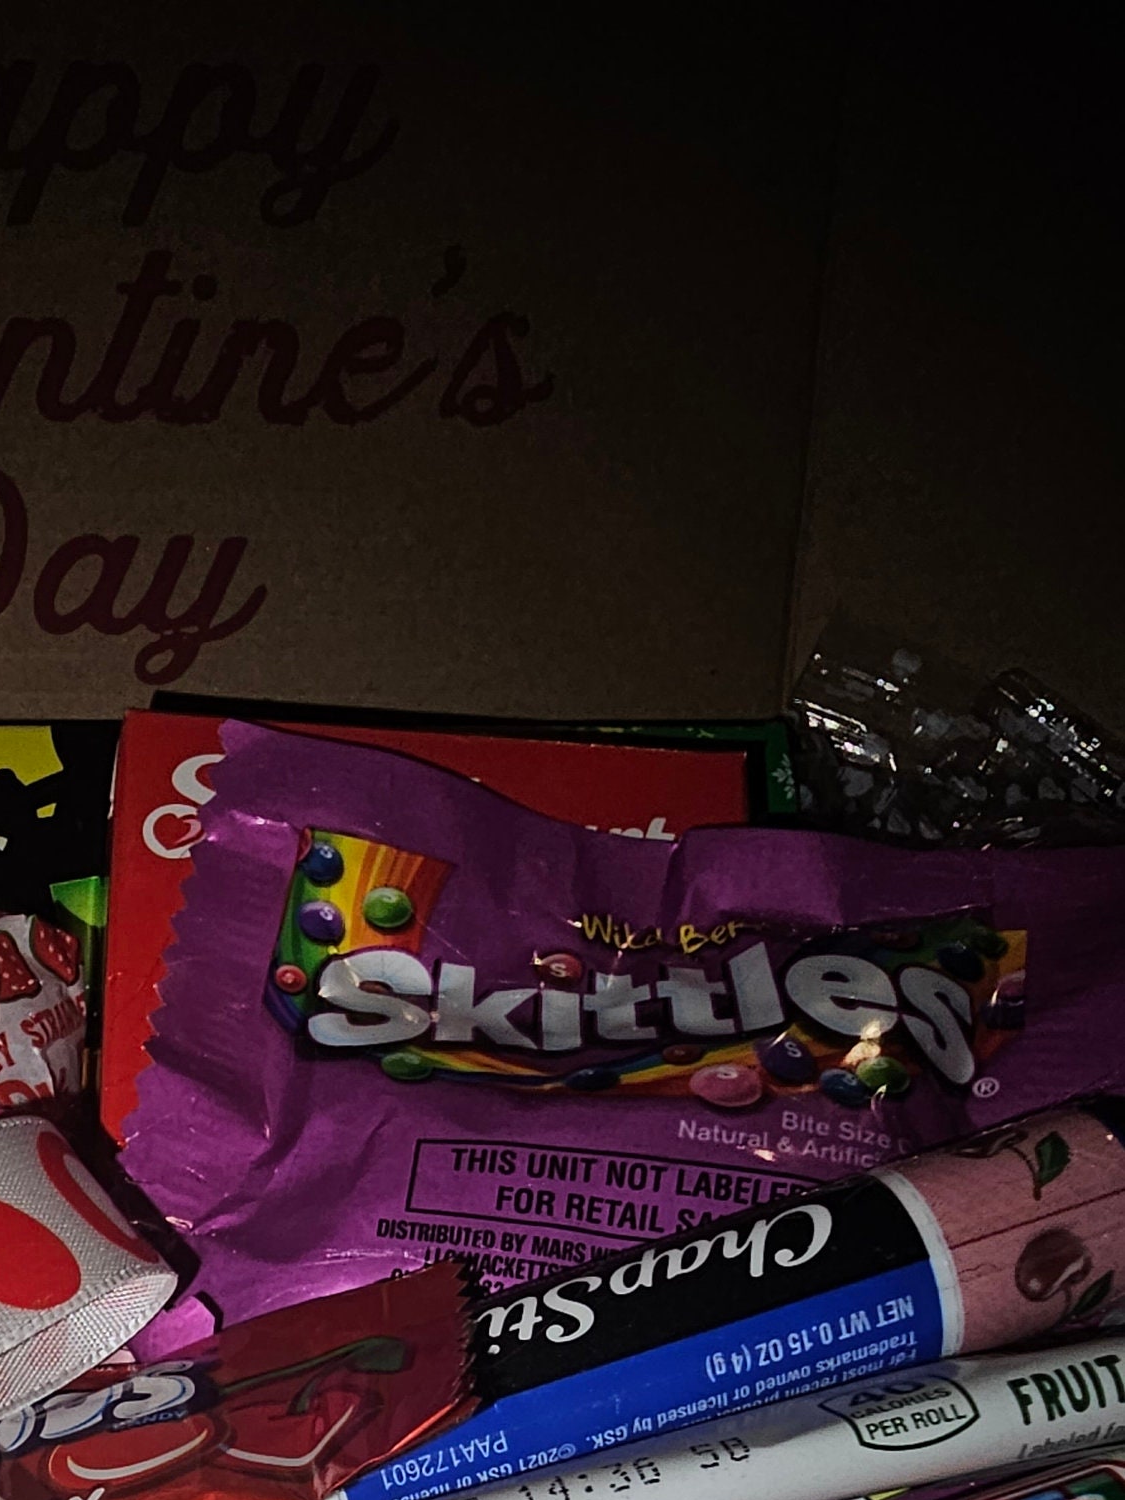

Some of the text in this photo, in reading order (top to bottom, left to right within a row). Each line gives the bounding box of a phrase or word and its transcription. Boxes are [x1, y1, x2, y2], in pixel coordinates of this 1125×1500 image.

[308, 942, 975, 1085] Skittles
[677, 1120, 769, 1148] Natural
[781, 1110, 830, 1136] Bite
[838, 1121, 891, 1149] Size
[451, 1148, 517, 1176] THIS
[527, 1153, 597, 1183] UNIT
[605, 1160, 667, 1192] NOT
[496, 1186, 555, 1217] FOR
[565, 1193, 665, 1234] RETAIL
[377, 1218, 496, 1249] DISTRIBUTED
[502, 1230, 527, 1253] BY
[531, 1236, 586, 1263] MARS
[839, 1310, 871, 1341] WT
[876, 1295, 915, 1328] NET
[755, 1338, 784, 1367] OZ
[787, 1322, 835, 1357] 0.15
[815, 1331, 918, 1373] Trademarks
[733, 1383, 751, 1400] or
[755, 1365, 811, 1394] owned
[1007, 1355, 1125, 1426] FRUIT
[656, 1392, 730, 1429] licensed
[850, 1388, 952, 1419] CALORIES
[584, 1426, 629, 1450] GSK.
[632, 1415, 653, 1434] by
[866, 1404, 967, 1440] PER ROLL
[380, 1430, 509, 1491] PAA172601
